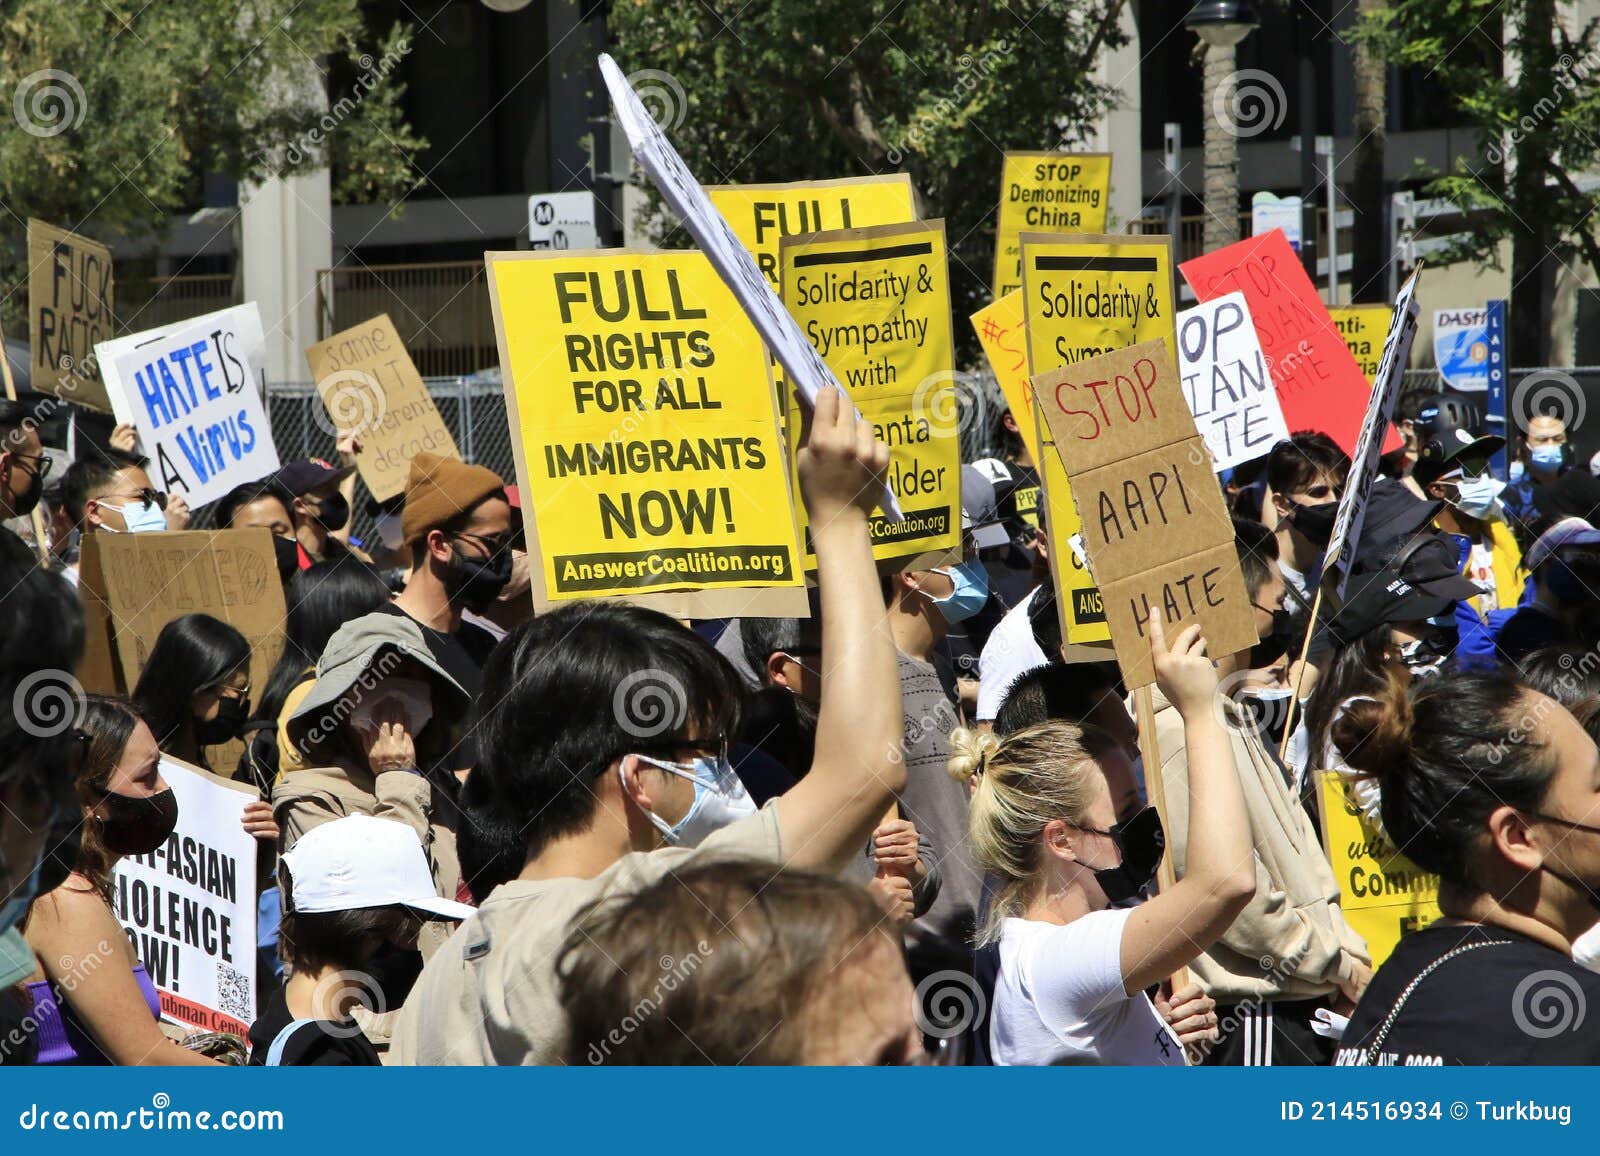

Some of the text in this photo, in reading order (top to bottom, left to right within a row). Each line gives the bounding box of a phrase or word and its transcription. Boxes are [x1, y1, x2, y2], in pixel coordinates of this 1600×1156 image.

[1009, 183, 1101, 208] Demonizing
[1035, 164, 1081, 182] STOP
[1025, 207, 1081, 227] China
[54, 241, 112, 326] FUCK
[553, 269, 707, 324] FULL
[797, 263, 934, 306] Solidarity &
[1040, 280, 1160, 328] Solidarity &
[807, 309, 928, 358] Sympathy
[1180, 302, 1244, 363] OP
[1252, 298, 1314, 347] SIAN
[1335, 317, 1365, 333] nti-
[564, 330, 715, 373] RIGHTS
[846, 356, 897, 388] with
[1491, 316, 1501, 399] LADOT
[134, 329, 245, 429] HATE IS
[572, 376, 722, 414] FOR ALL
[1055, 358, 1157, 440] STOP
[1182, 349, 1266, 418] IAN
[872, 414, 930, 446] anta
[1212, 404, 1274, 458] TE
[156, 442, 189, 494] A
[544, 437, 767, 478] IMMIGRANTS
[889, 458, 945, 497] lder
[598, 487, 737, 540] NOW!
[1099, 464, 1192, 544] AAPI
[562, 550, 784, 582] AnswerCoalition.org
[1130, 567, 1225, 637] HATE
[119, 874, 233, 964] IOLENCE
[162, 996, 207, 1026] ubman
